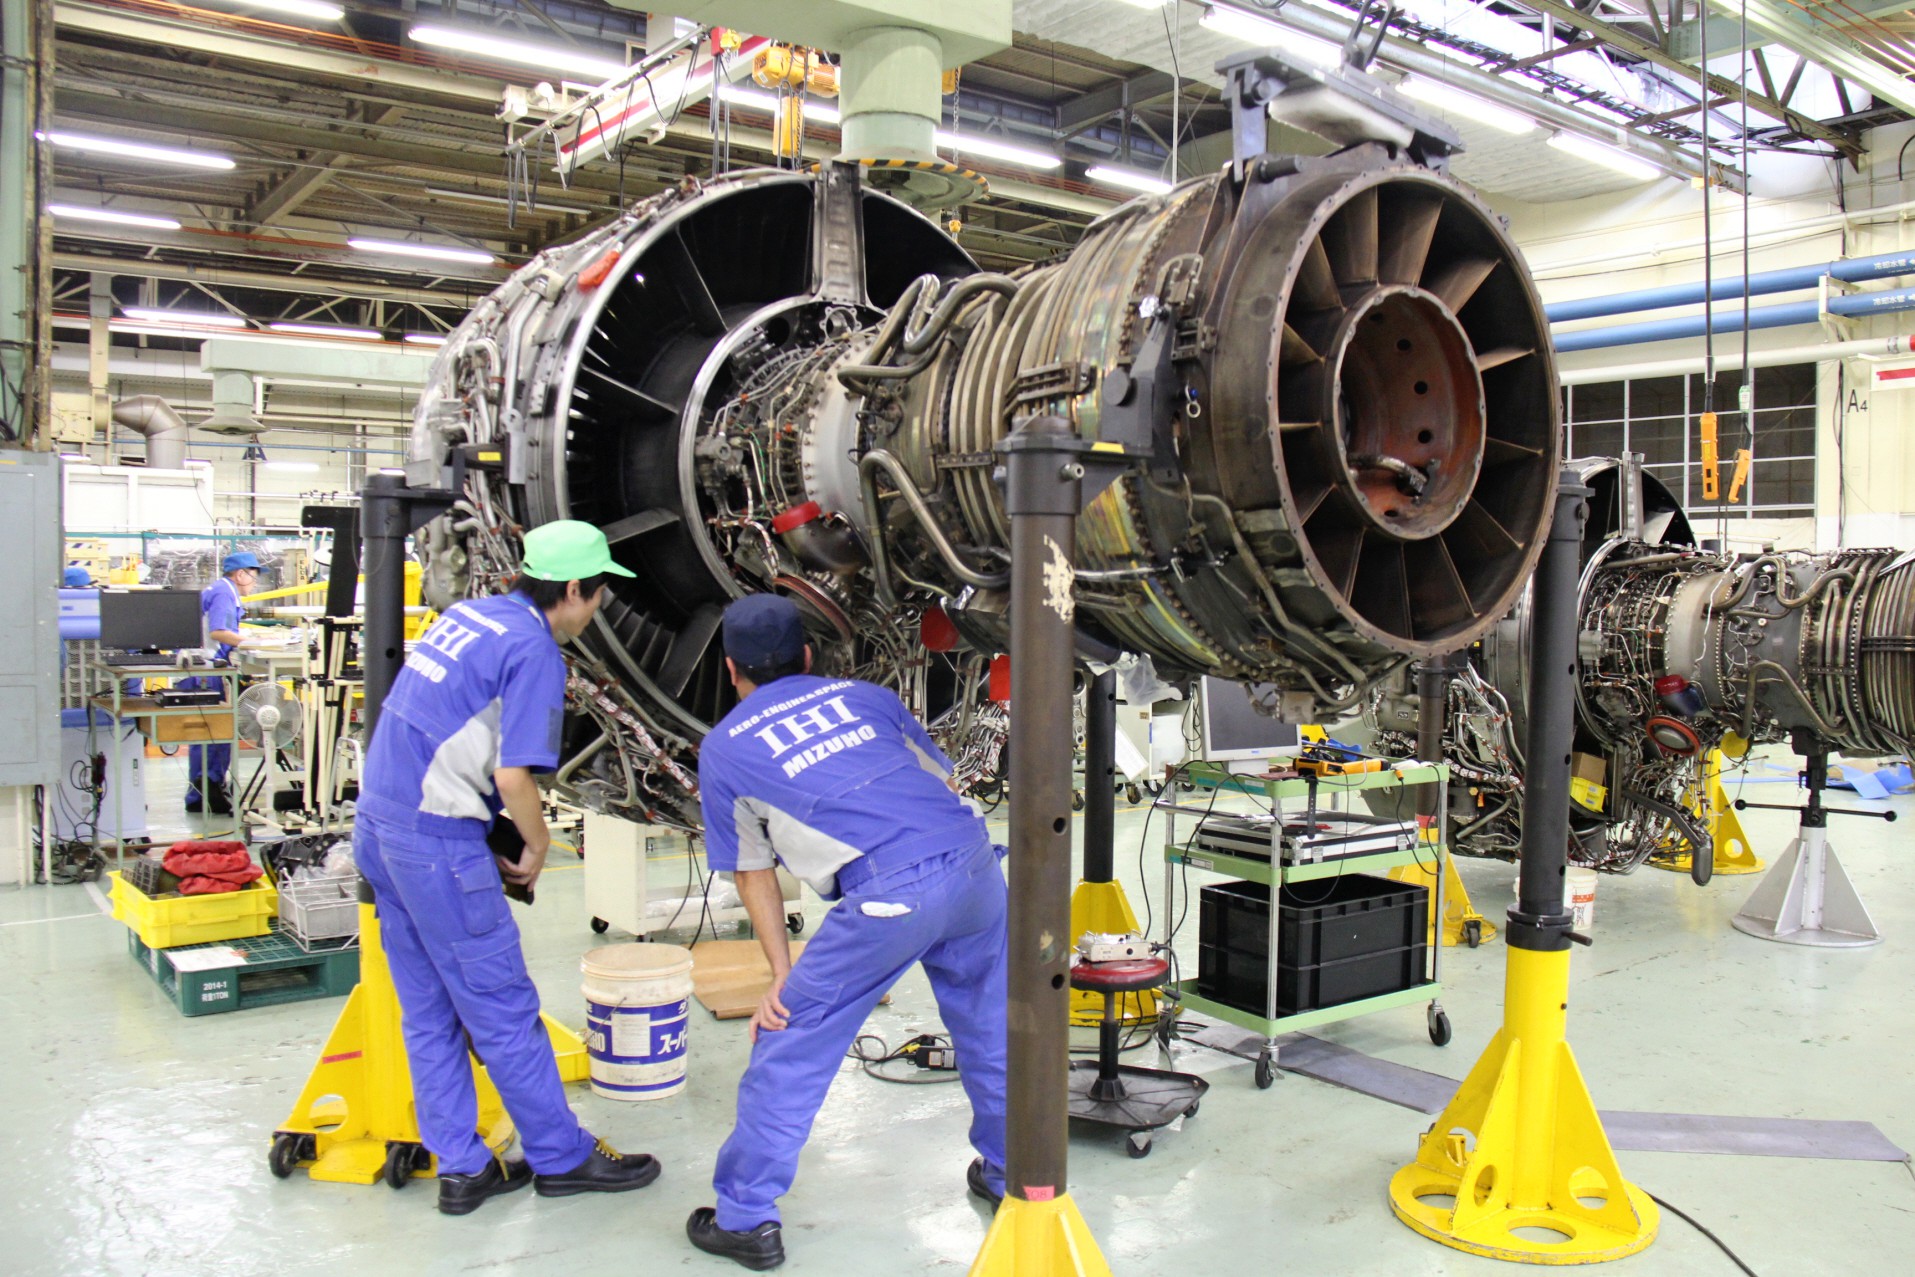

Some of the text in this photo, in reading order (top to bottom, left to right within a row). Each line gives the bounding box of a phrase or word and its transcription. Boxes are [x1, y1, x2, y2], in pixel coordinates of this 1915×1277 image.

[754, 695, 861, 759] IHI
[781, 725, 877, 779] MIZUHO
[203, 981, 227, 991] 2014-1
